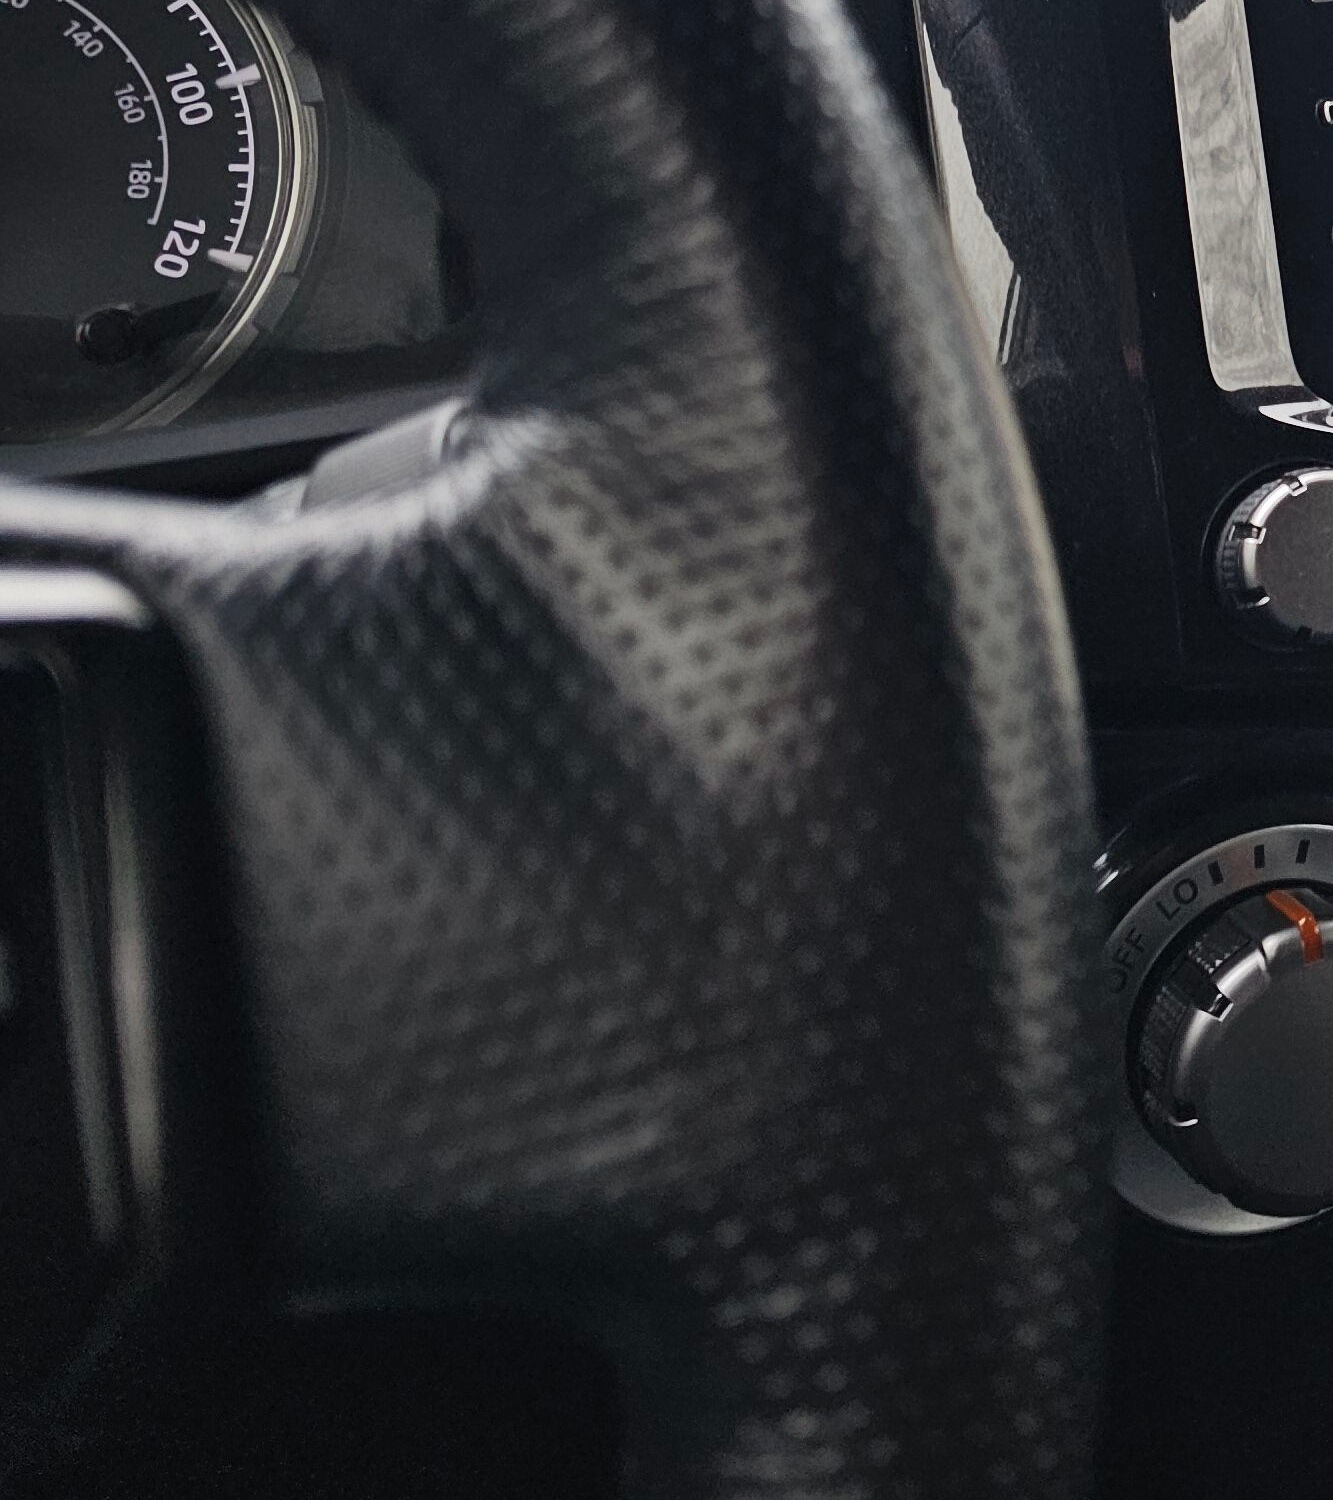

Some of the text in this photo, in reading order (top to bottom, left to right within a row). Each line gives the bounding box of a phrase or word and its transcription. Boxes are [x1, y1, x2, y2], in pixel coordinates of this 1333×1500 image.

[63, 20, 104, 57] 140
[113, 83, 146, 124] 160
[166, 63, 213, 126] 100
[126, 160, 153, 199] 180
[154, 219, 206, 279] 120
[1156, 877, 1199, 921] LO
